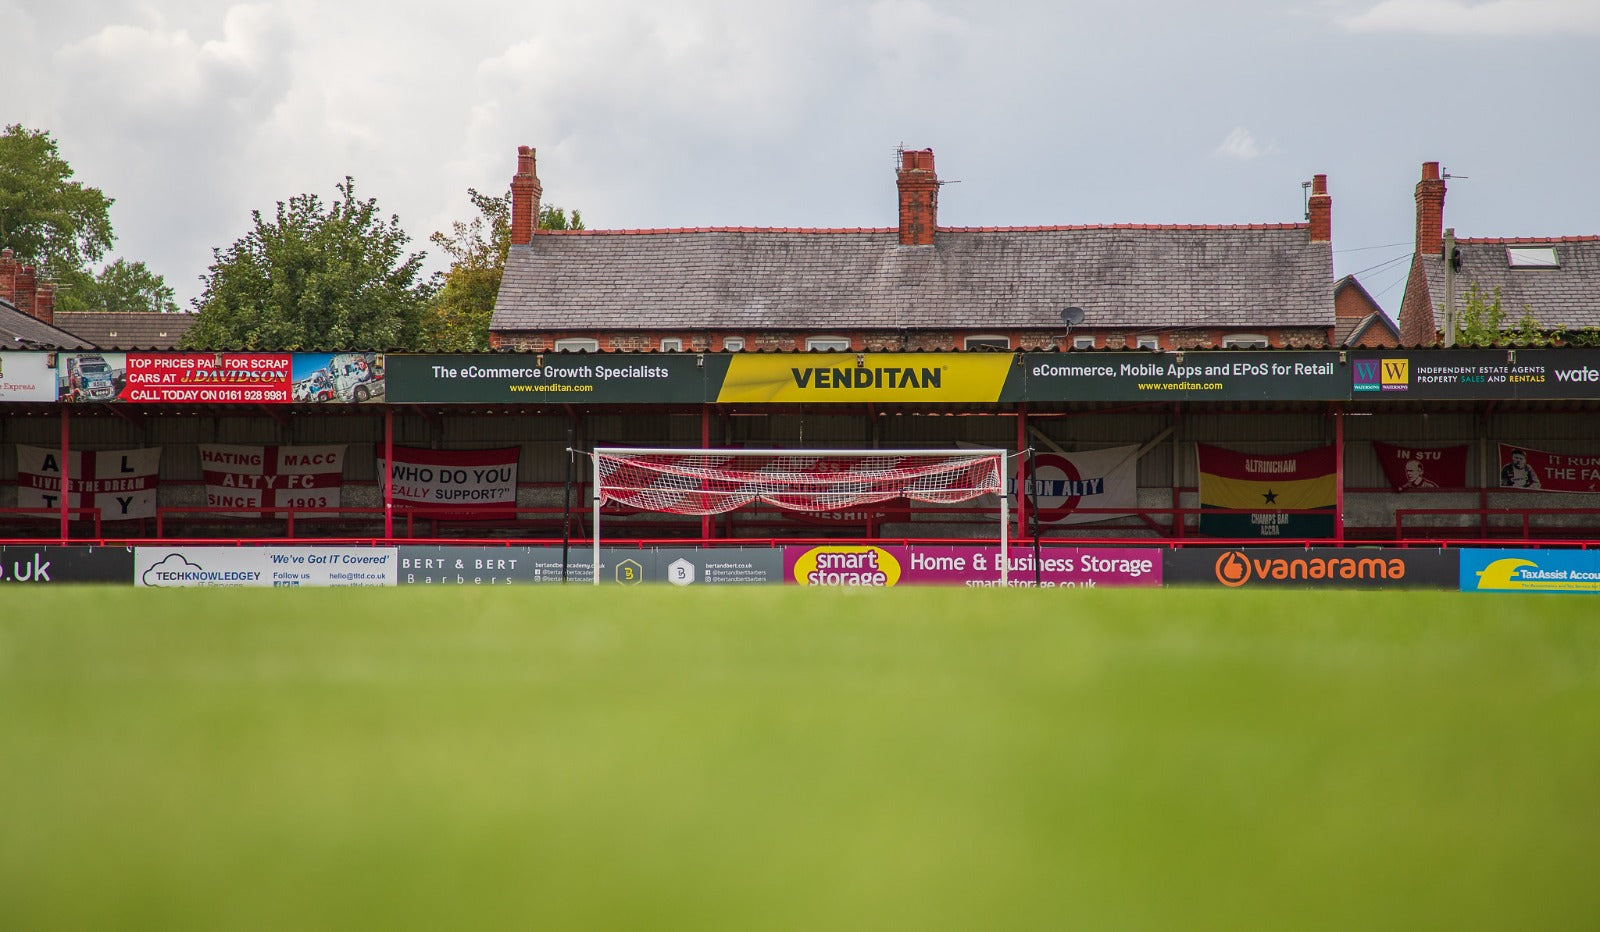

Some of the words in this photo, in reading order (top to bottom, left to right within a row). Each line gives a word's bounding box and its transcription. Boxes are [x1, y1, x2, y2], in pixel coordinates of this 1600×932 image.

[129, 359, 151, 368] TOP
[154, 359, 194, 368] PRICES
[197, 359, 221, 368] PAI
[225, 359, 248, 368] FOR
[251, 359, 288, 368] SCRAP
[1032, 364, 1117, 377] eCommerce,
[1120, 363, 1164, 376] Mobile
[1167, 364, 1202, 379] Apps
[1205, 363, 1230, 376] and
[1233, 363, 1269, 376] EPoS
[1271, 363, 1291, 376] for
[1295, 362, 1334, 375] Retail
[1356, 362, 1377, 380] W
[1384, 362, 1406, 380] W
[1479, 366, 1509, 374] ESTATE
[1511, 366, 1545, 374] AGENTS
[129, 373, 160, 383] CARS
[162, 373, 176, 383] AT
[180, 370, 288, 383] J.DAVIDSON
[432, 365, 458, 378] The
[460, 365, 541, 378] eCommerce
[544, 365, 592, 378] Growth
[595, 365, 669, 380] Specialists
[791, 368, 941, 388] VENDITAN
[1461, 375, 1485, 383] SALES
[1487, 375, 1507, 383] AND
[1509, 375, 1545, 383] RENTALS
[1554, 366, 1600, 382] wate
[510, 383, 593, 392] www.venditan.com
[1138, 381, 1223, 390] www.venditan.com
[130, 390, 160, 400] CALL
[162, 390, 198, 400] TODAY
[200, 390, 217, 400] ON
[219, 390, 241, 400] 0161
[244, 390, 262, 400] 928
[264, 390, 287, 400] 9981
[202, 450, 261, 466] HATING
[284, 453, 336, 466] MACC
[1397, 450, 1411, 459] IN
[1416, 451, 1441, 460] STU
[1549, 455, 1561, 465] IT
[41, 454, 59, 472] A
[121, 455, 134, 473] L
[1245, 459, 1297, 474] ALTRINCHAM
[222, 473, 277, 489] ALTY
[288, 474, 314, 489] FC
[439, 469, 467, 484] DO
[473, 467, 512, 483] YOU
[1544, 467, 1576, 480] THE
[78, 480, 100, 492] THE
[104, 477, 145, 491] DREAM
[1062, 479, 1099, 496] ALTY
[42, 494, 57, 508] T
[117, 496, 133, 514] Y
[208, 494, 256, 508] SINCE
[287, 496, 327, 509] 1903
[1251, 513, 1276, 525] CHAMPS
[1277, 513, 1289, 525] BAR
[1260, 525, 1280, 536] ACCRA
[0, 553, 50, 581] .uk
[308, 555, 327, 564] Got
[329, 555, 340, 564] IT
[402, 558, 445, 569] BERT
[454, 559, 464, 569] &
[475, 559, 518, 569] BERT
[817, 551, 878, 569] smart
[910, 553, 966, 570] Home
[973, 553, 987, 571] &
[1080, 554, 1153, 577] Storage
[156, 572, 261, 580] TECHKNOWLEDGEY
[1253, 558, 1406, 580] vanarama
[1520, 569, 1568, 579] TaxAssist
[407, 574, 512, 585] Barbers
[808, 569, 886, 587] storage
